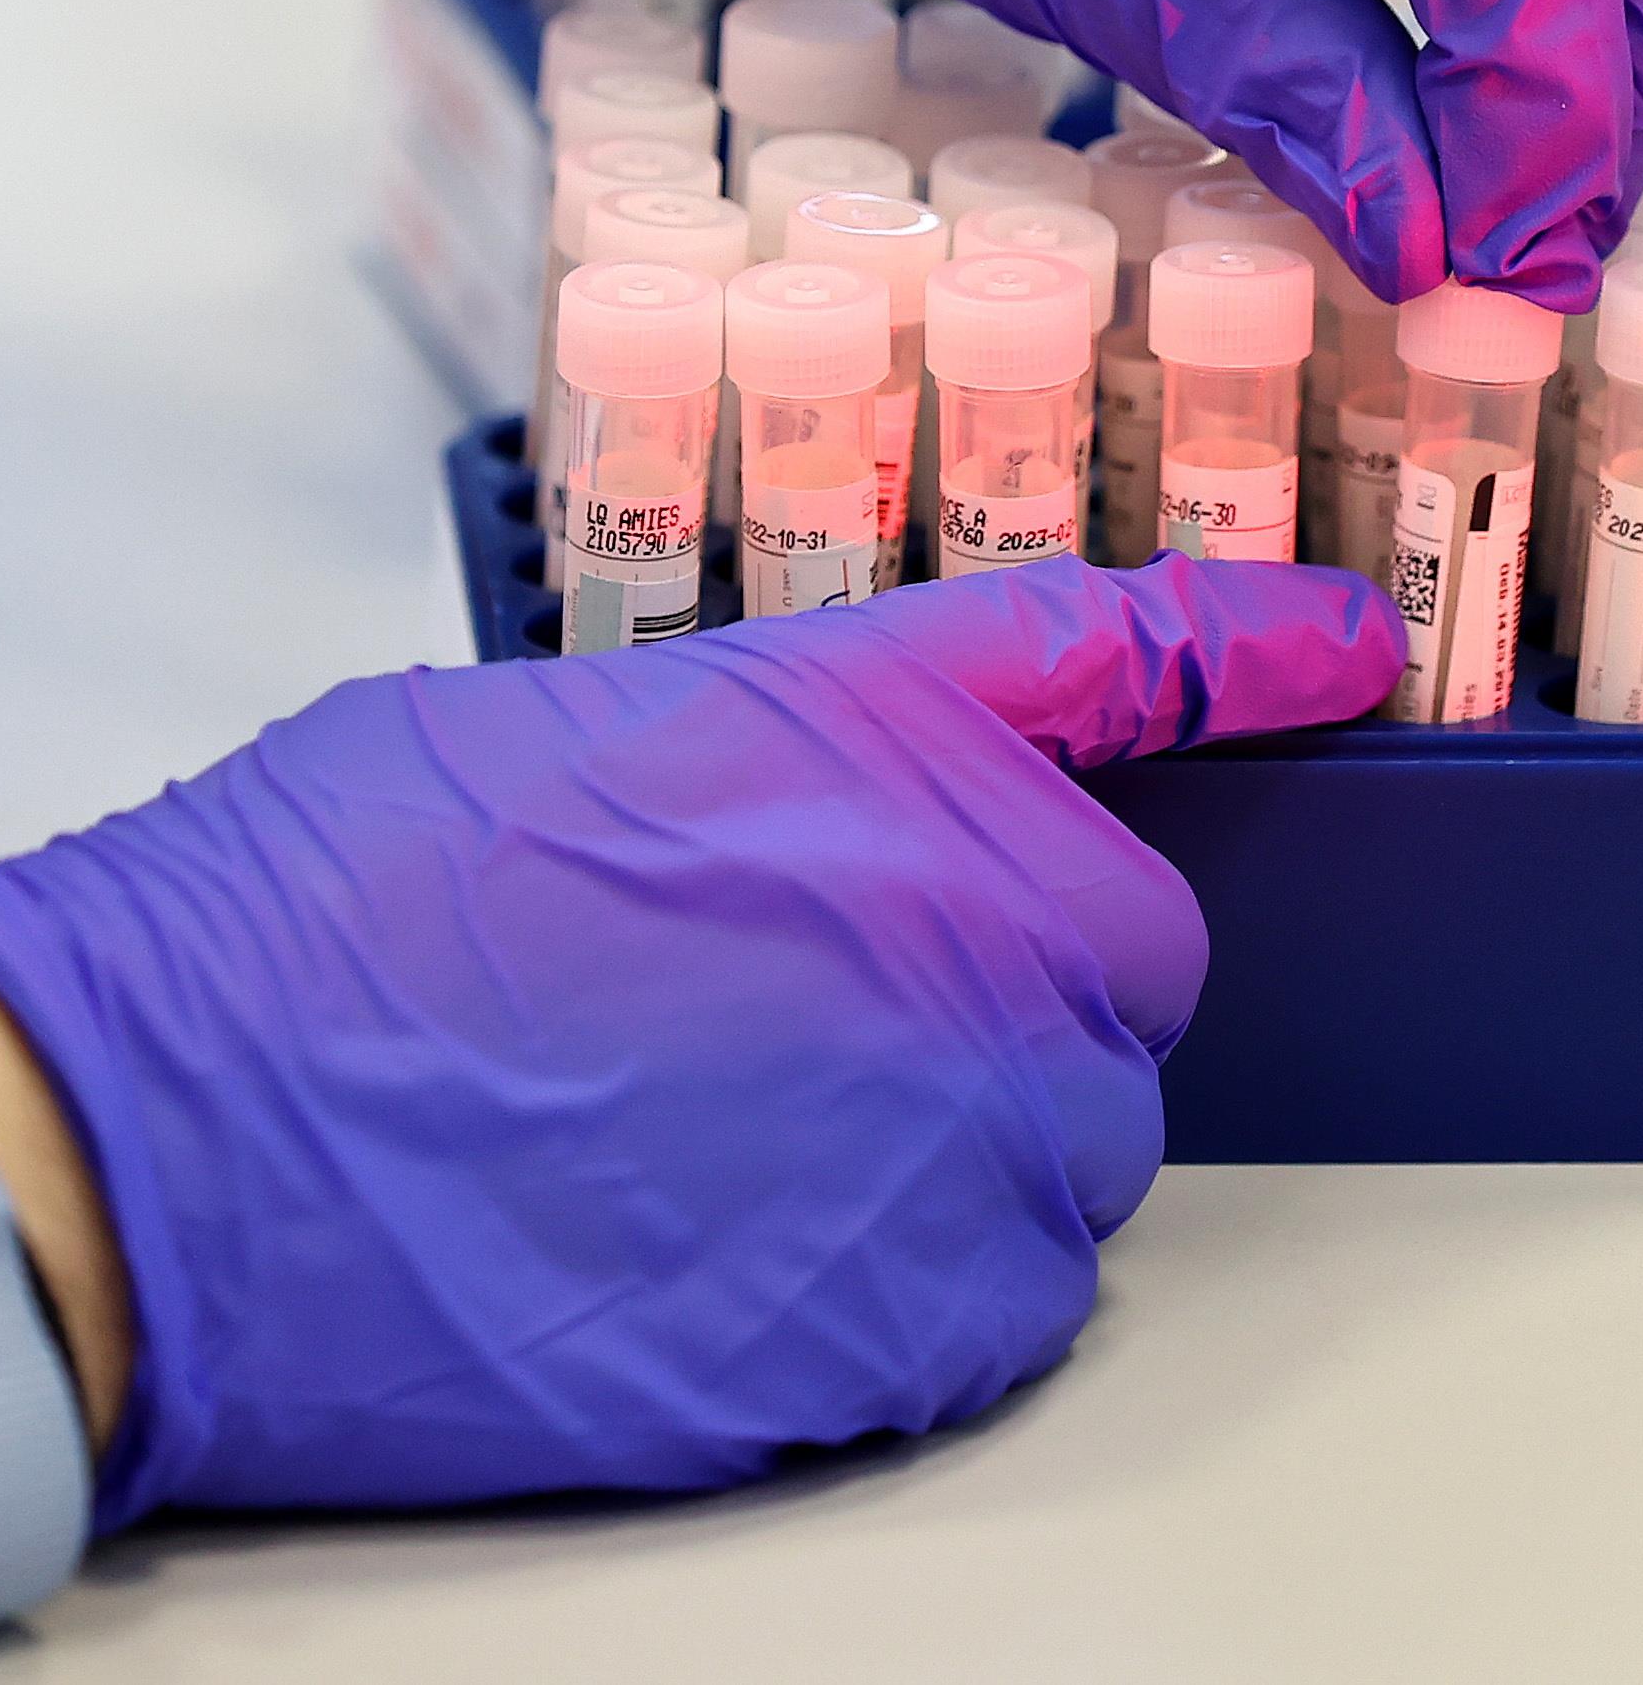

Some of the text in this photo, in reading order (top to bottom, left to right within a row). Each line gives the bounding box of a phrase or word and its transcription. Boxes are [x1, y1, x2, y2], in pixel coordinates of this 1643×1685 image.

[586, 500, 681, 532] LQ AMIES
[586, 525, 667, 556] 2105790
